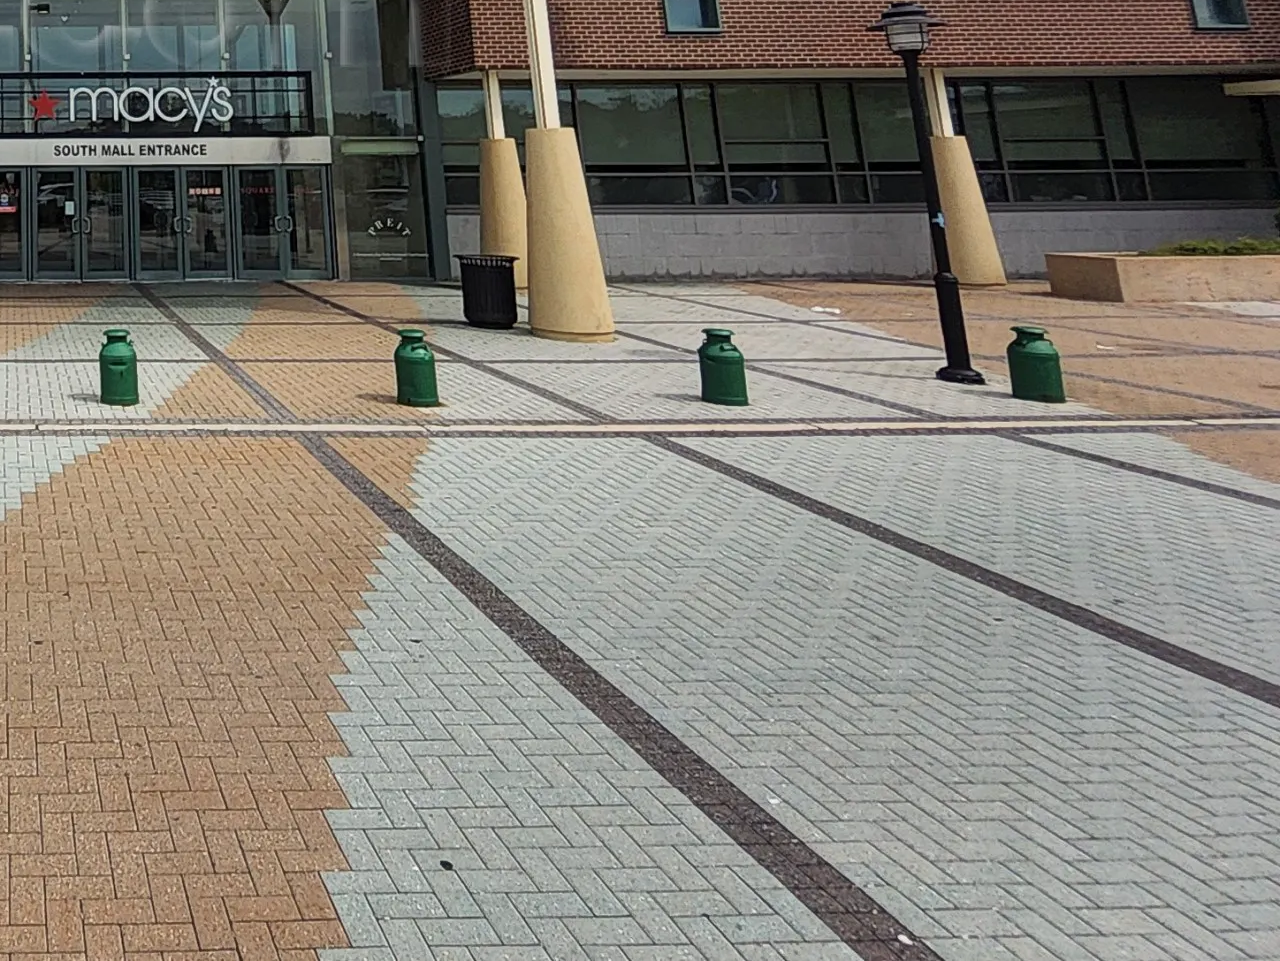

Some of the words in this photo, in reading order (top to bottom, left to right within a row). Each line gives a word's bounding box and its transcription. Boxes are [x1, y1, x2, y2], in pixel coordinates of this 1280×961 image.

[53, 144, 97, 157] SOUTH
[101, 144, 135, 157] MALL
[140, 144, 208, 157] ENTRANCE
[368, 218, 411, 236] PREIT
